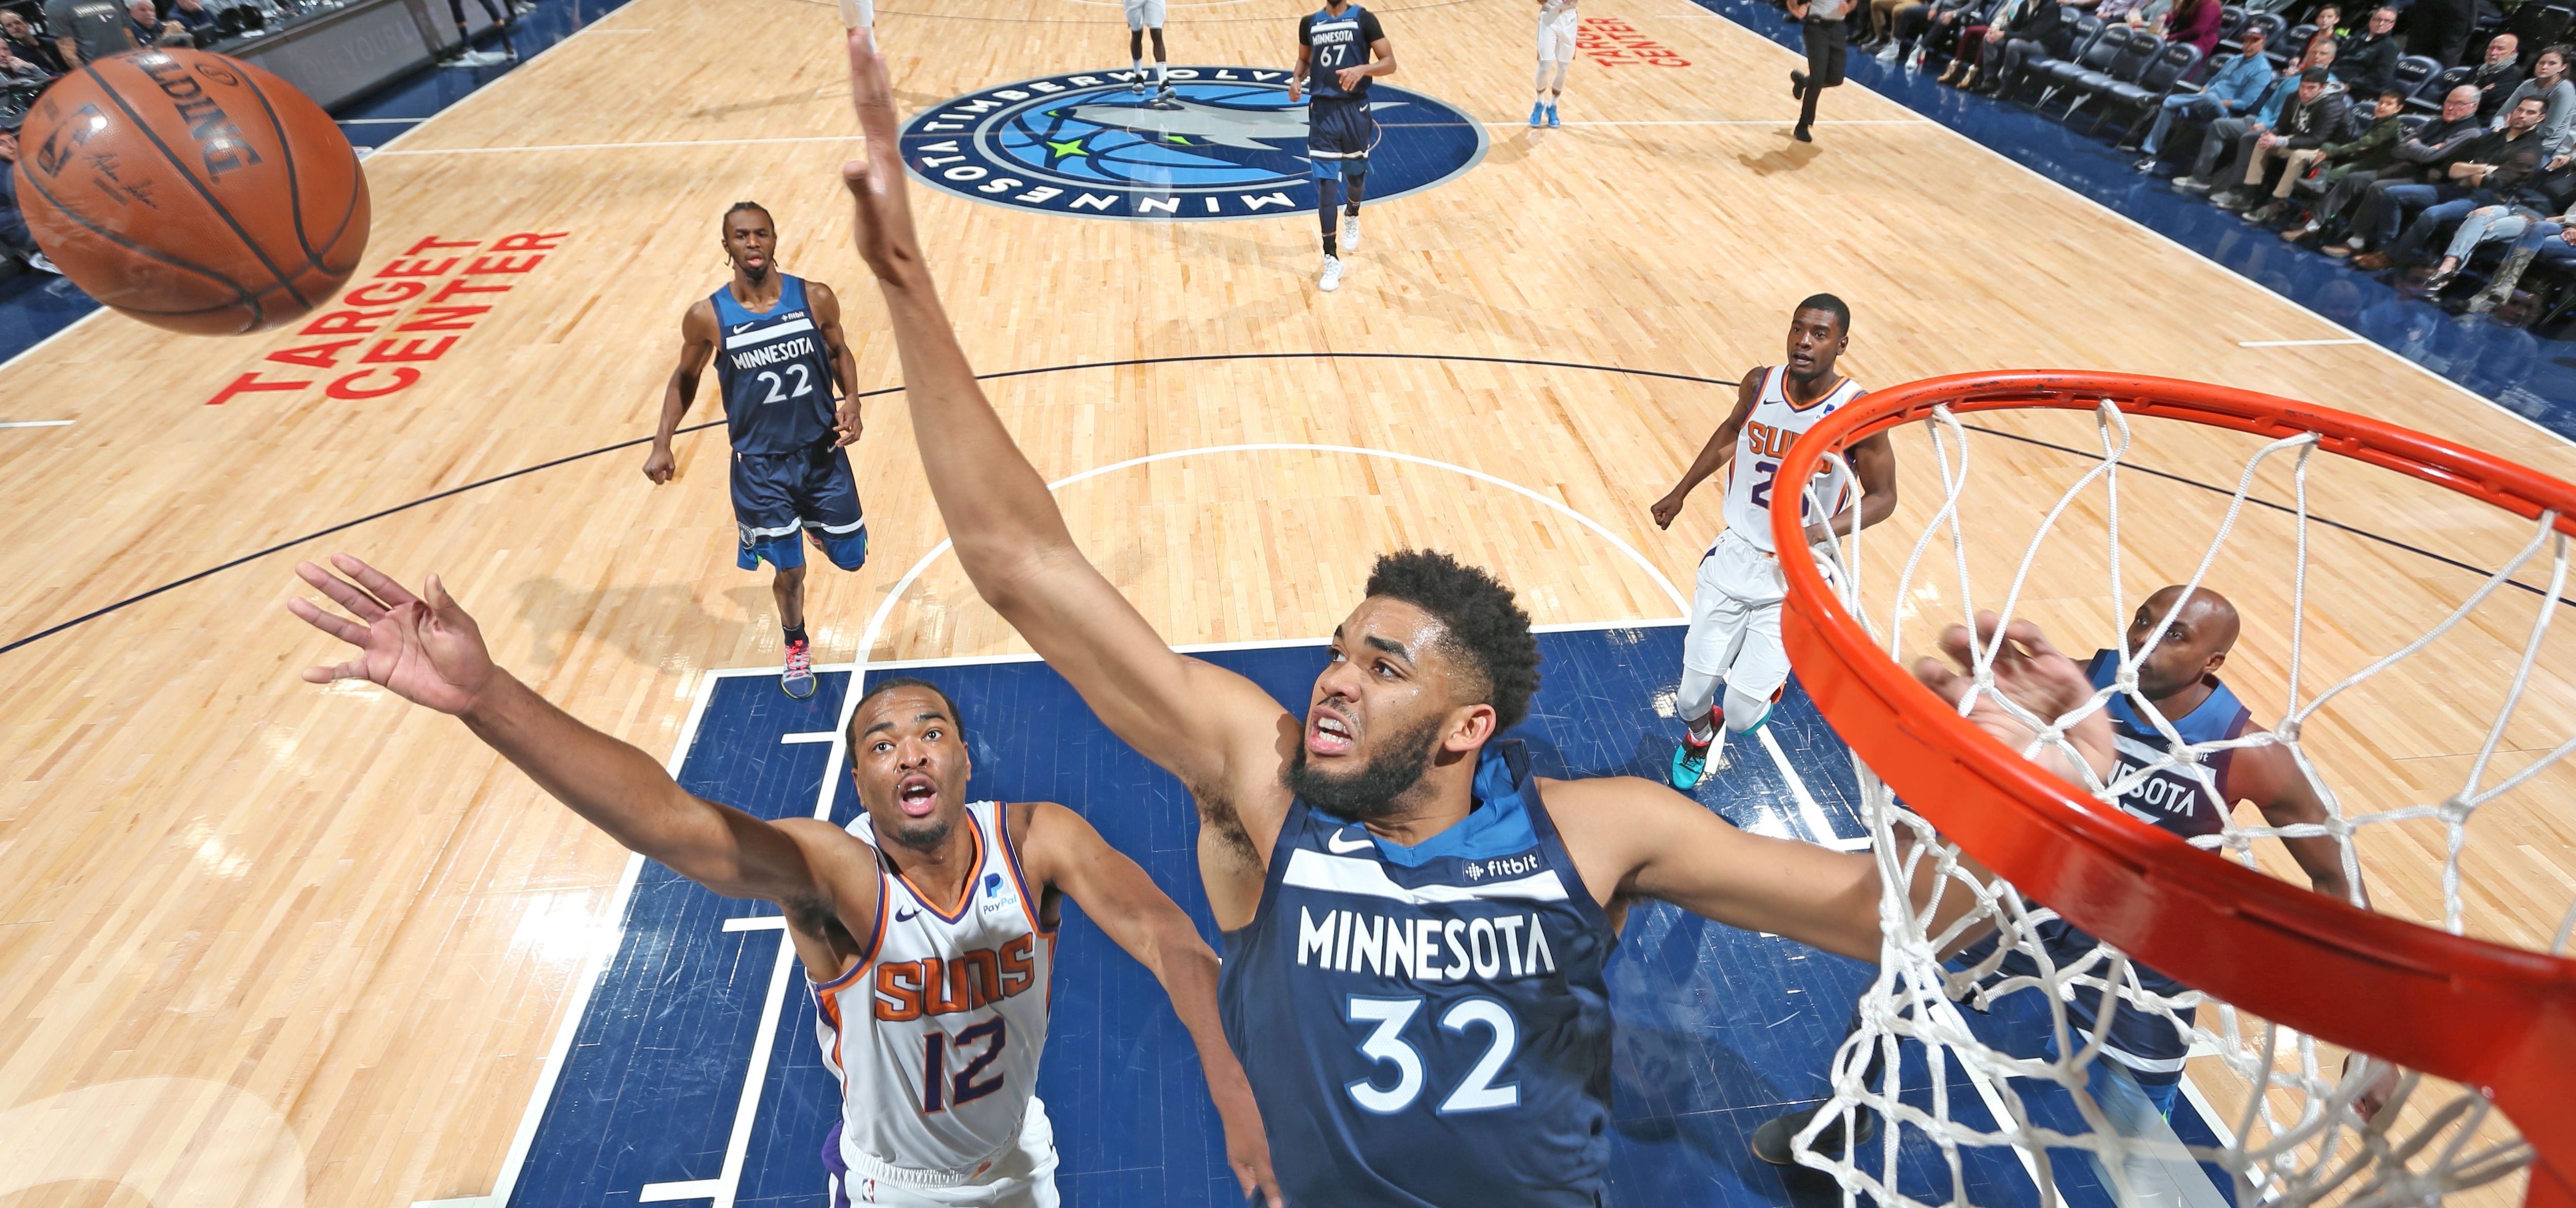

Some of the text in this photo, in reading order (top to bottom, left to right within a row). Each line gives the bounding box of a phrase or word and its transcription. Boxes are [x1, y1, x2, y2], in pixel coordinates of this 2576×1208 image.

[1313, 30, 1353, 45] MINNESOTA
[1320, 44, 1346, 67] 67
[1585, 18, 1692, 66] CENTER
[917, 140, 1296, 210] MINNESOTA
[205, 236, 483, 405] TARGET
[326, 231, 570, 400] CENTER
[787, 311, 805, 320] fitbit
[731, 337, 815, 370] MINNESOTA
[757, 364, 812, 404] 22
[1487, 854, 1538, 877] fitbit
[983, 894, 1017, 915] PayPal
[1297, 905, 1556, 980] MINNESOTA
[874, 932, 1035, 1022] SUNS
[922, 1014, 1006, 1115] 12
[1344, 993, 1521, 1116] 32
